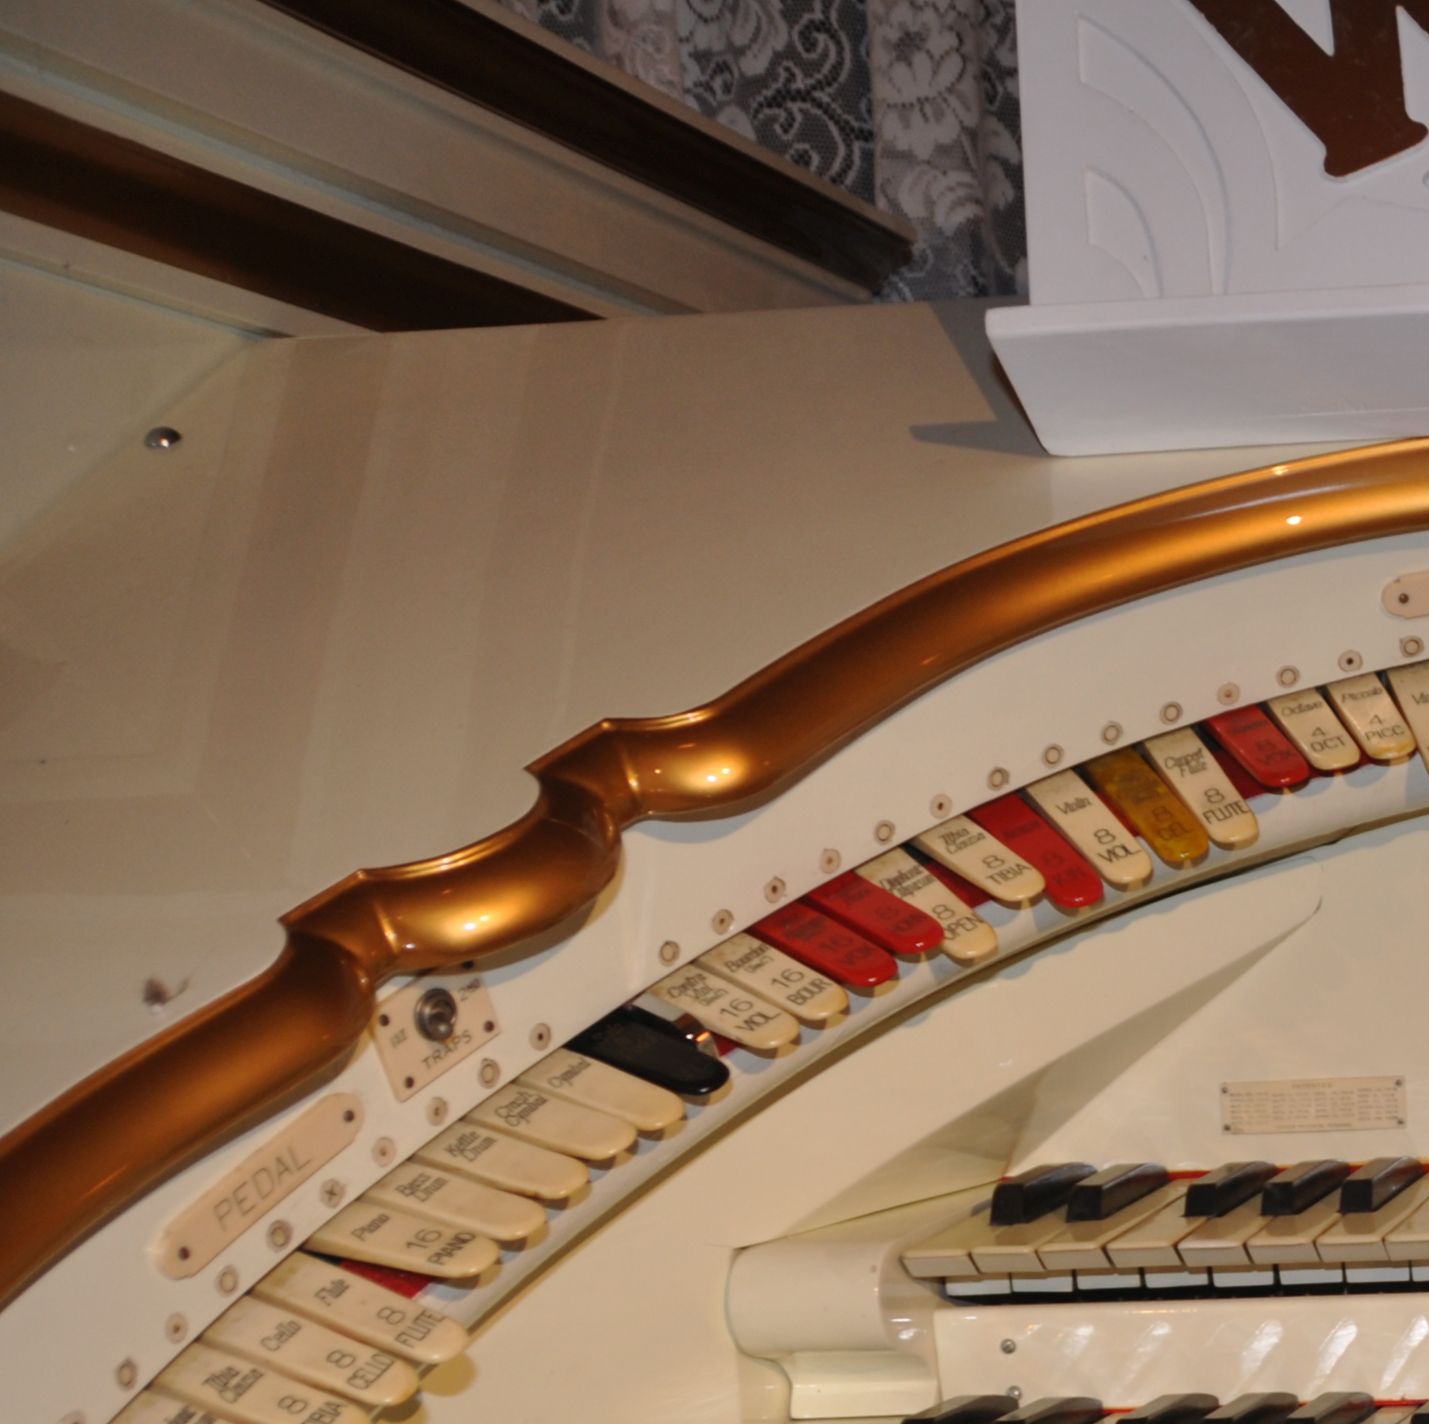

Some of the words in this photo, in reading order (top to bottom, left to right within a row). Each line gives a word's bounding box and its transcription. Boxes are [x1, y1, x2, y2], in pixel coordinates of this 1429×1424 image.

[1368, 713, 1384, 726] 4
[1311, 726, 1327, 738] 4
[1363, 724, 1406, 743] PICC
[1309, 735, 1347, 753] OCT
[1054, 796, 1094, 816] Violin
[1204, 787, 1225, 804] 8
[1202, 801, 1249, 826] FLUTE
[938, 827, 970, 846] Tibia
[945, 832, 987, 855] Clausa
[1093, 828, 1117, 845] 8
[981, 853, 1006, 871] 8
[1096, 843, 1142, 865] VIOL
[984, 863, 1031, 886] TIBIA
[931, 903, 956, 923] 8
[944, 913, 986, 942] OPEN
[771, 967, 805, 988] 16
[786, 977, 832, 1007] BOUR
[720, 996, 755, 1018] 16
[735, 1007, 782, 1033] VIOL
[420, 1029, 472, 1071] TRAPS
[547, 1057, 592, 1088] Cymbal
[495, 1091, 531, 1118] Crash
[504, 1094, 549, 1127] Cymbal
[445, 1131, 480, 1157] Kettle
[461, 1136, 497, 1162] Drum
[212, 1145, 313, 1234] PEDAL
[412, 1177, 449, 1202] Drum
[351, 1213, 391, 1240] Piano
[406, 1229, 442, 1252] 16
[426, 1230, 476, 1268] PIANO
[314, 1279, 350, 1307] Flute
[376, 1306, 406, 1326] 8
[261, 1320, 302, 1351] Cello
[394, 1309, 447, 1349] FLUTE
[327, 1350, 357, 1369] 8
[202, 1366, 240, 1388] Tibia
[346, 1353, 396, 1390] CELLO
[277, 1395, 308, 1415] 8
